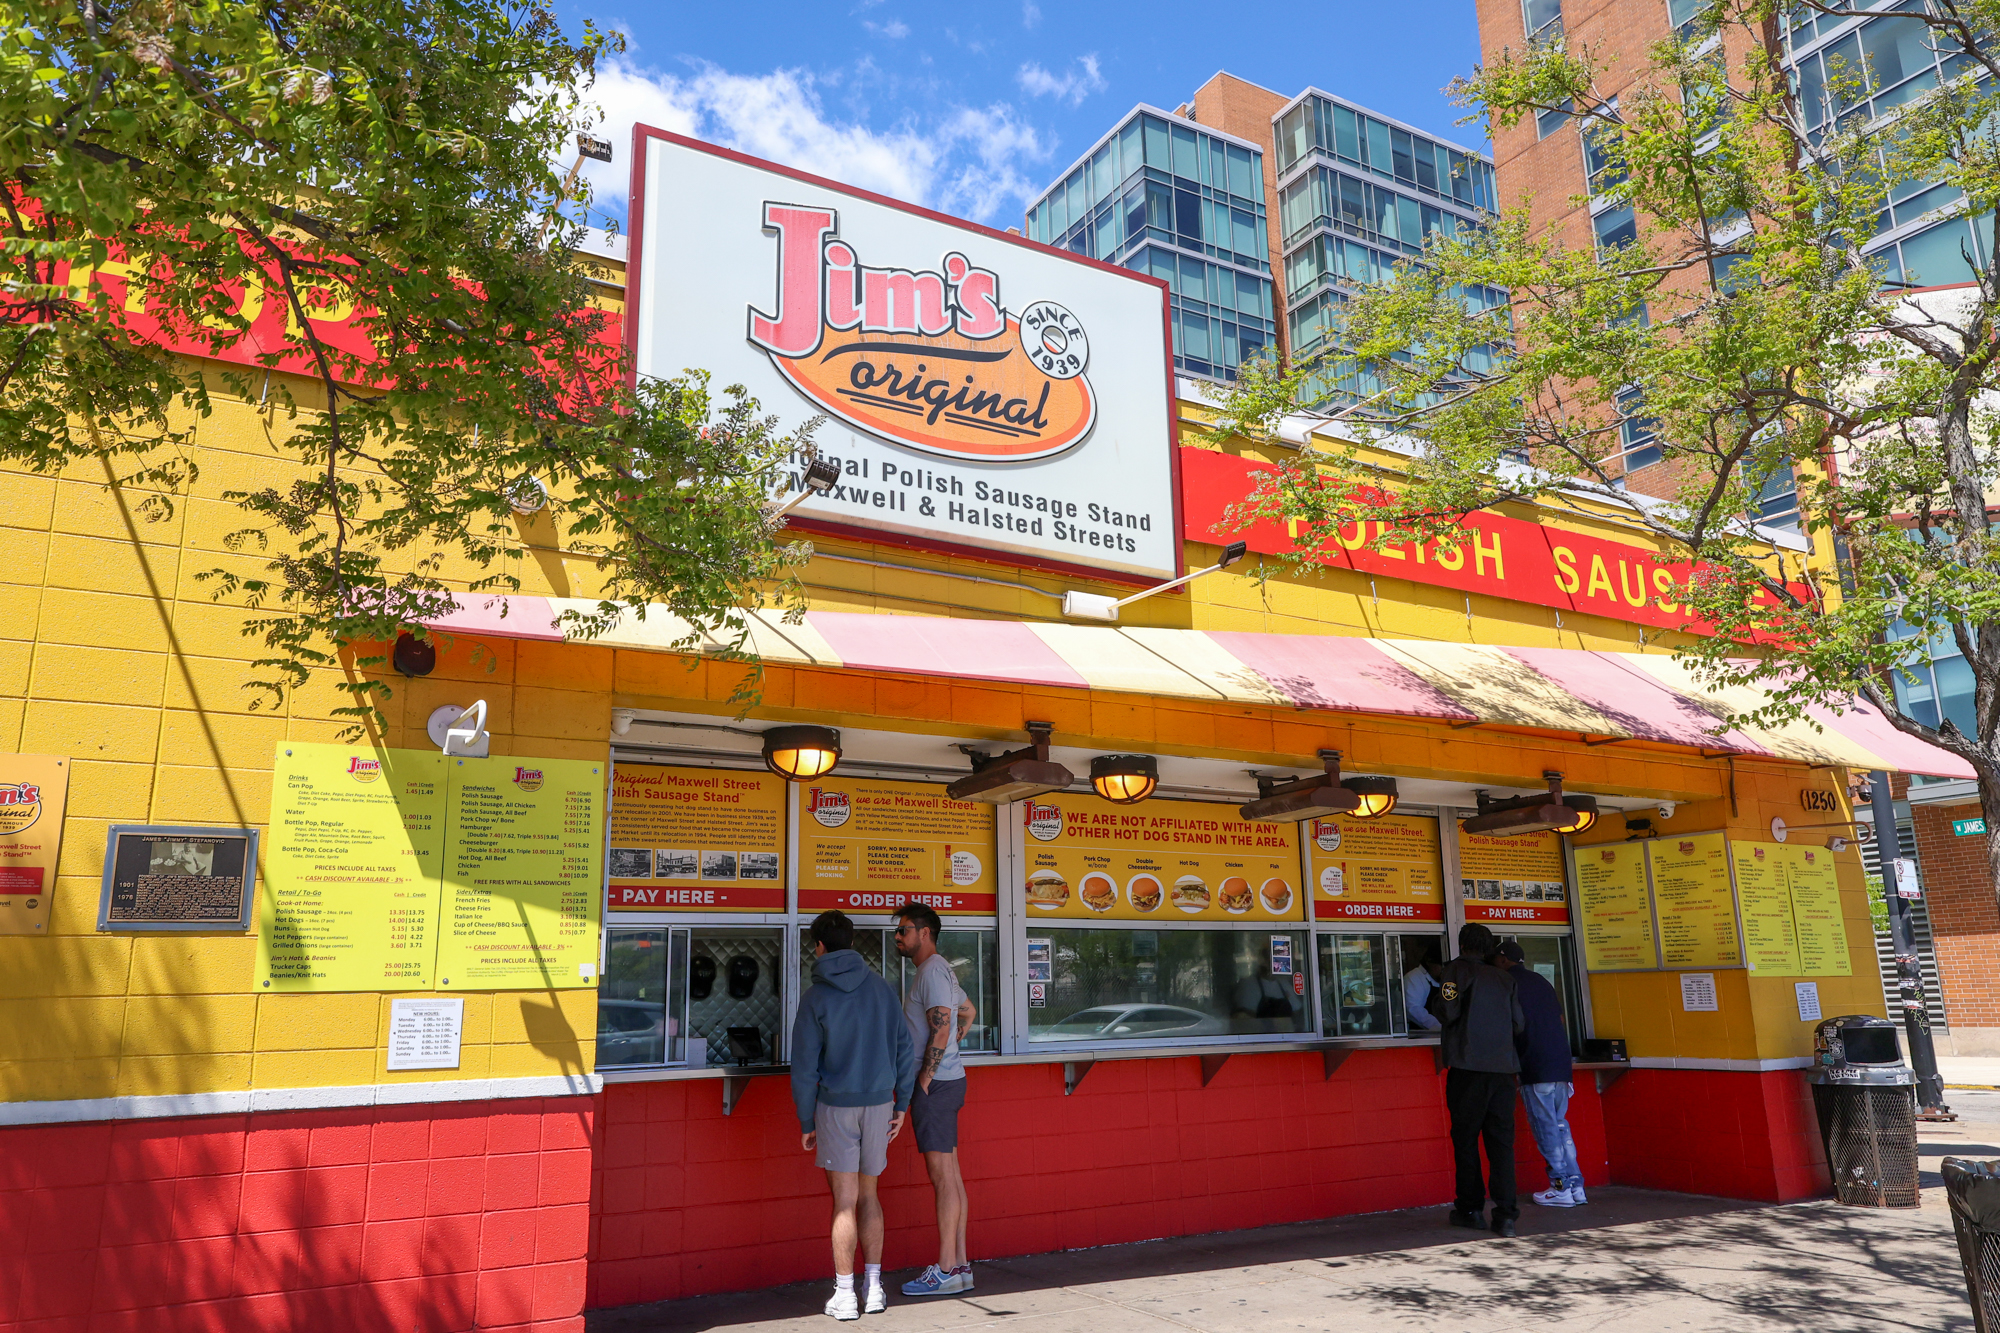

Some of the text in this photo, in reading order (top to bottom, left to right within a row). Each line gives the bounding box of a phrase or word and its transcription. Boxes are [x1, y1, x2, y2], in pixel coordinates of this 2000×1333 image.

[747, 201, 1006, 358] Jim's
[1026, 306, 1083, 341] SINCE
[1032, 346, 1079, 376] 1939
[851, 363, 1050, 435] original
[883, 465, 963, 495] Polish
[976, 482, 1077, 518] Sausage
[1088, 504, 1151, 532] Stand
[920, 496, 936, 517] &
[950, 504, 1043, 536] Halsted
[1055, 523, 1136, 552] Streets
[1553, 545, 1769, 631] SAUSE
[347, 757, 381, 773] Jim's
[612, 769, 760, 790] Original Maxwell Street
[0, 782, 40, 806] m's
[612, 788, 639, 798] olish
[645, 790, 699, 802] Sausage
[806, 787, 850, 813] Jim's
[895, 797, 938, 808] Maxwell
[942, 800, 977, 810] Street.
[1806, 791, 1836, 811] 1250
[818, 808, 847, 817] original
[1024, 800, 1062, 826] Jim's
[1067, 812, 1278, 834] WE ARE NOT AFFILIATED WITH ANY
[1032, 822, 1060, 832] original
[1068, 826, 1109, 839] OTHER
[1114, 829, 1138, 840] HOT
[1144, 830, 1169, 841] DOG
[1174, 832, 1211, 844] STAND
[1216, 834, 1226, 844] IN
[1231, 836, 1252, 846] THE
[1256, 837, 1289, 847] AREA.
[1312, 819, 1340, 841] Jim's
[1370, 826, 1399, 835] Maxwell
[1401, 828, 1425, 836] Street.
[1964, 821, 1985, 834] JAMES
[1469, 837, 1489, 845] Polish
[1492, 838, 1518, 847] Sausage
[623, 889, 714, 903] PAY HERE
[850, 894, 905, 906] ORDER
[1345, 904, 1414, 916] ORDER HERE
[1489, 908, 1535, 918] PAY HERE
